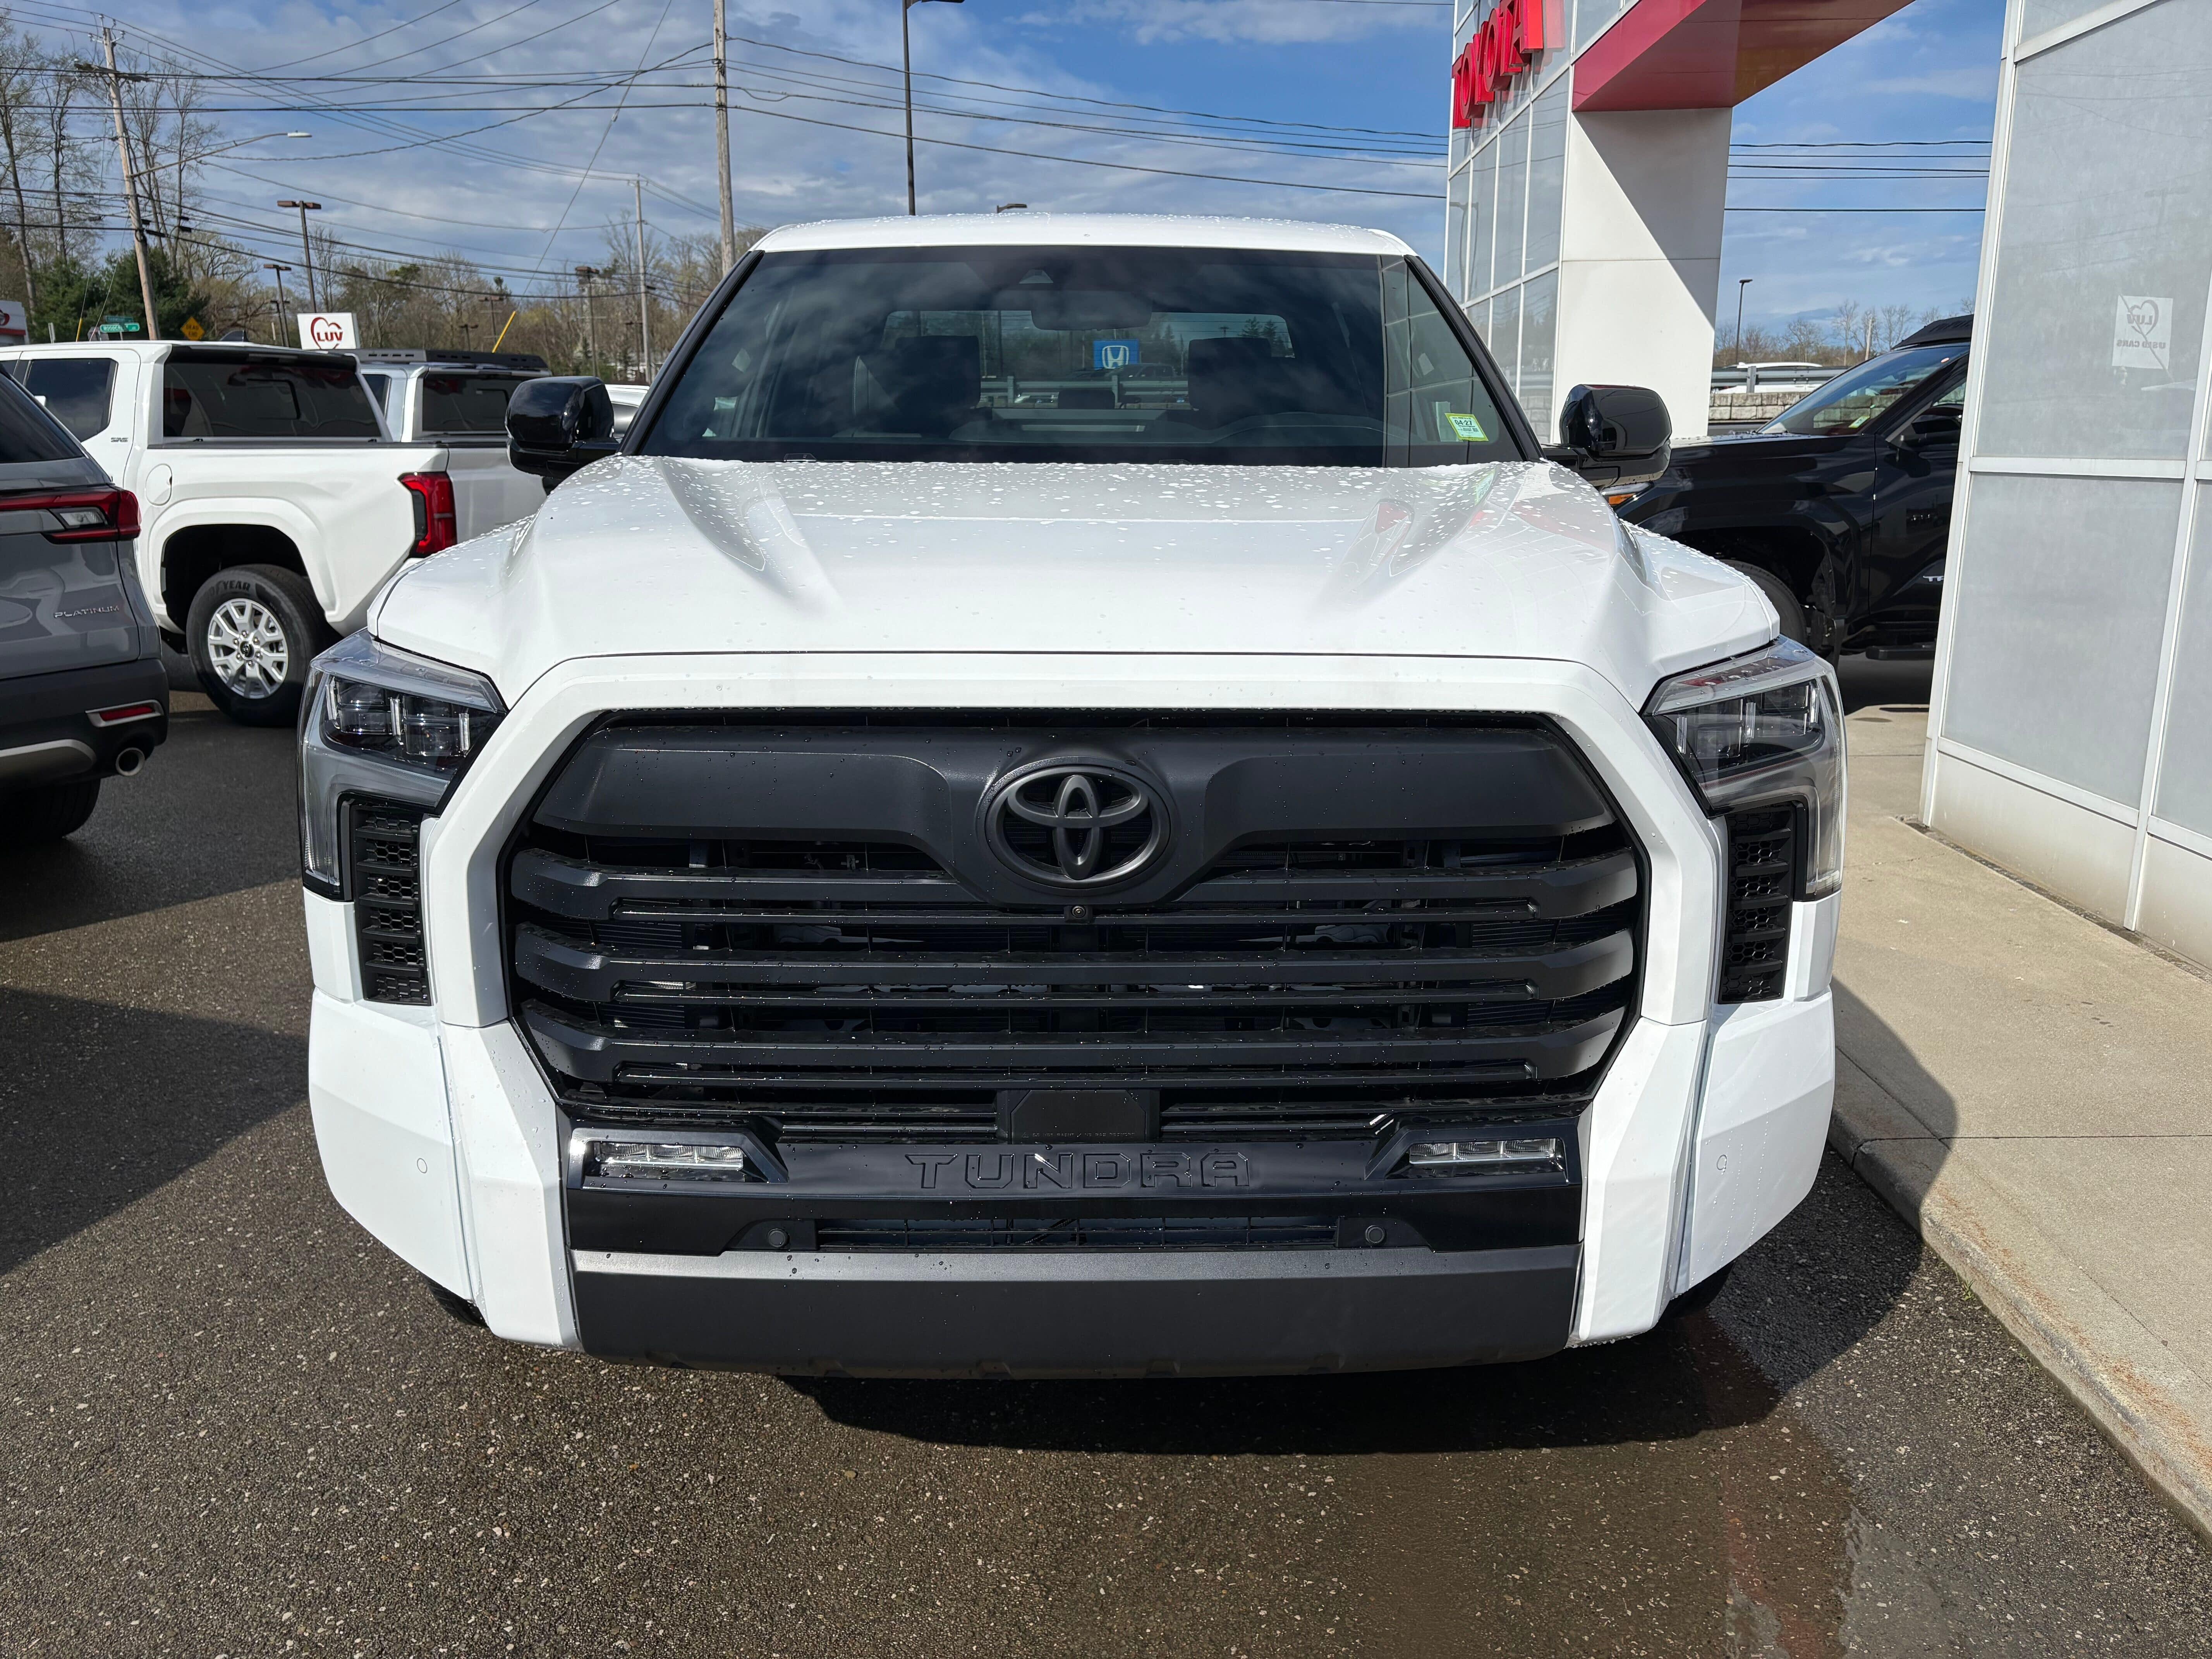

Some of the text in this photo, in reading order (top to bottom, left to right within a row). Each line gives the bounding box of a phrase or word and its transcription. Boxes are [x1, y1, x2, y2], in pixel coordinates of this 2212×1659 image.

[316, 331, 343, 342] LUV
[54, 605, 119, 618] PLATINUM
[905, 1152, 1250, 1189] TUNDRA
